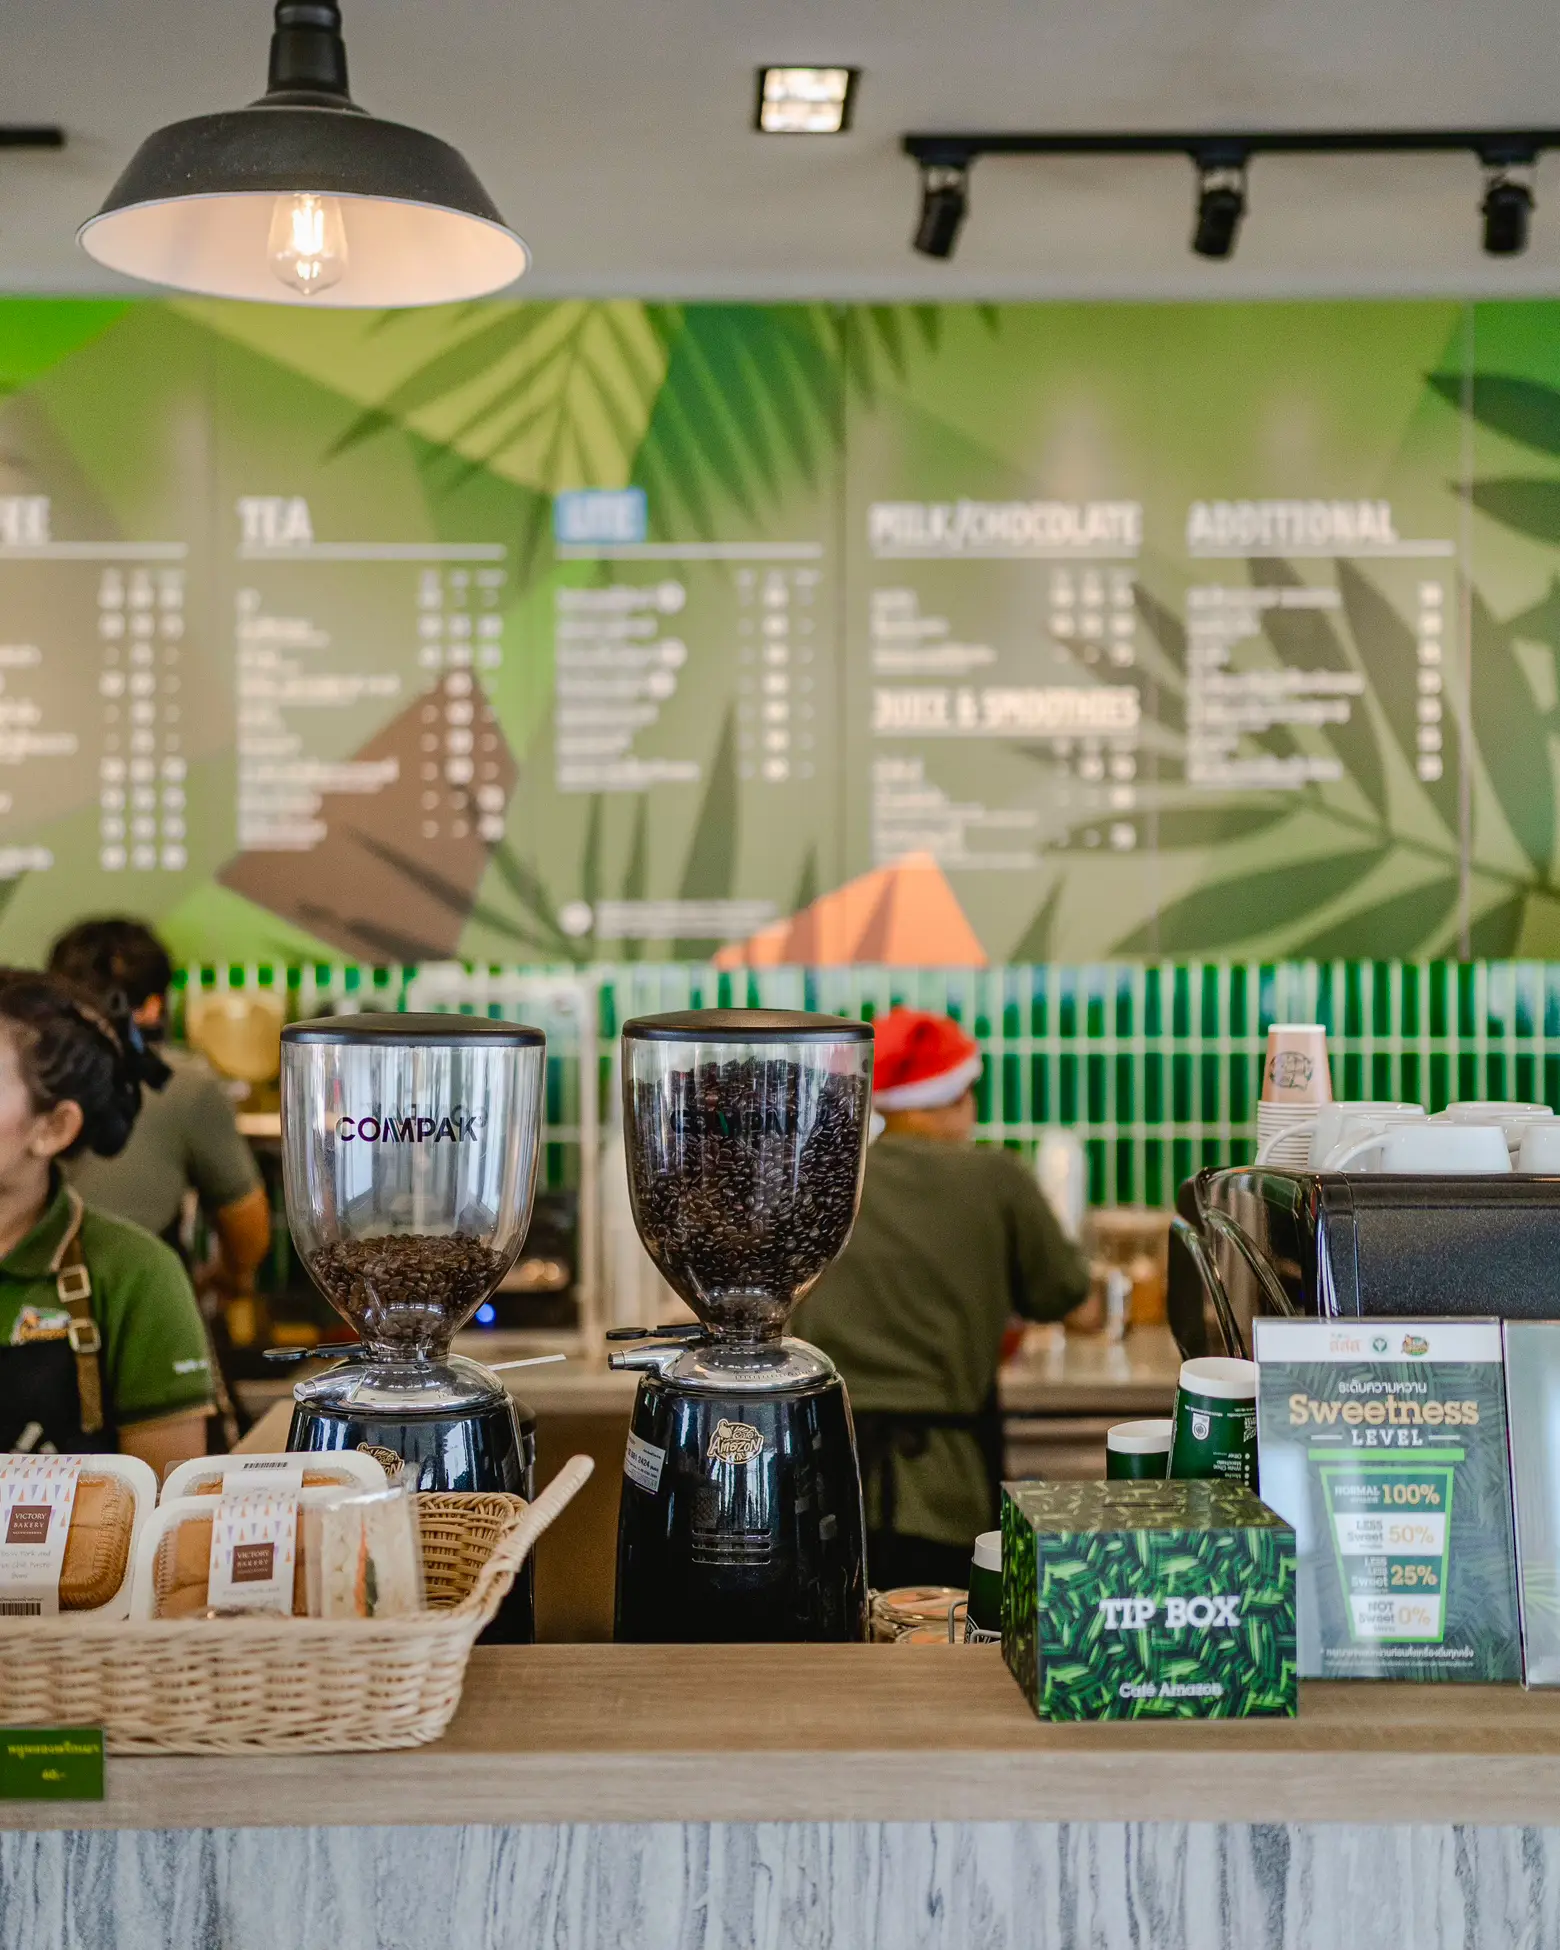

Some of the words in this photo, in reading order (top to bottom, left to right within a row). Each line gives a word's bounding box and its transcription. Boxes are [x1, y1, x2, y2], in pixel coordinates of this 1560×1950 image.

[336, 1116, 479, 1142] COMPAK
[1288, 1393, 1480, 1426] Sweetness
[1351, 1428, 1423, 1446] LEVEL
[1334, 1486, 1380, 1497] NORMAL
[1382, 1484, 1441, 1505] 100%
[1388, 1525, 1434, 1544] 50%
[236, 1549, 270, 1559] VICTORY
[1390, 1564, 1439, 1586] 25%
[1099, 1598, 1156, 1630] TIP
[1164, 1596, 1241, 1628] BOX
[1368, 1601, 1395, 1612] NOT
[1398, 1606, 1431, 1626] 0%
